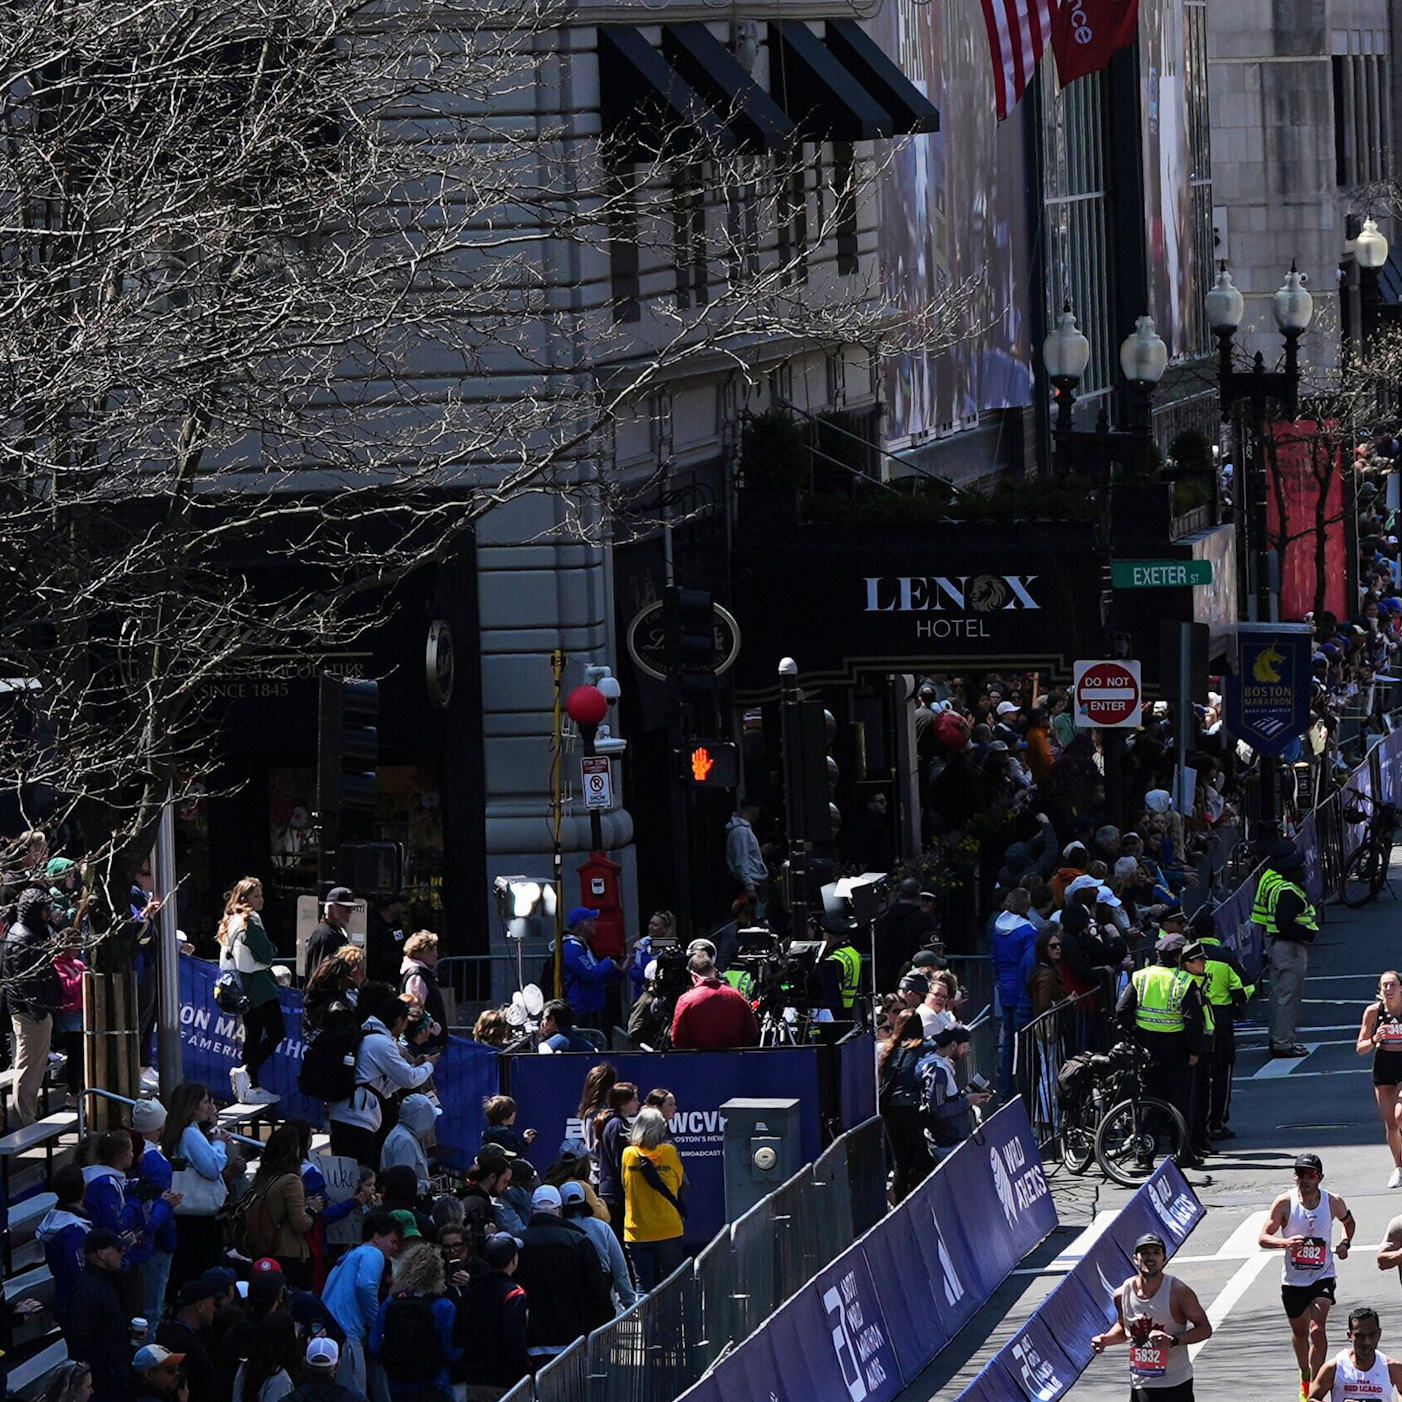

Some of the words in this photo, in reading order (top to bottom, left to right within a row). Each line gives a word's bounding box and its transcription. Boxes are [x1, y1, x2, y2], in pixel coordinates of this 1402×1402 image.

[1133, 565, 1187, 586] EXETER
[917, 619, 990, 637] HOTEL
[1085, 676, 1102, 687] DO
[1107, 676, 1129, 687] NOT
[201, 684, 247, 697] SINCE
[253, 683, 288, 697] 1845
[1245, 686, 1292, 697] BOSTON
[1090, 701, 1126, 711] ENTER
[1135, 1350, 1160, 1363] 5832
